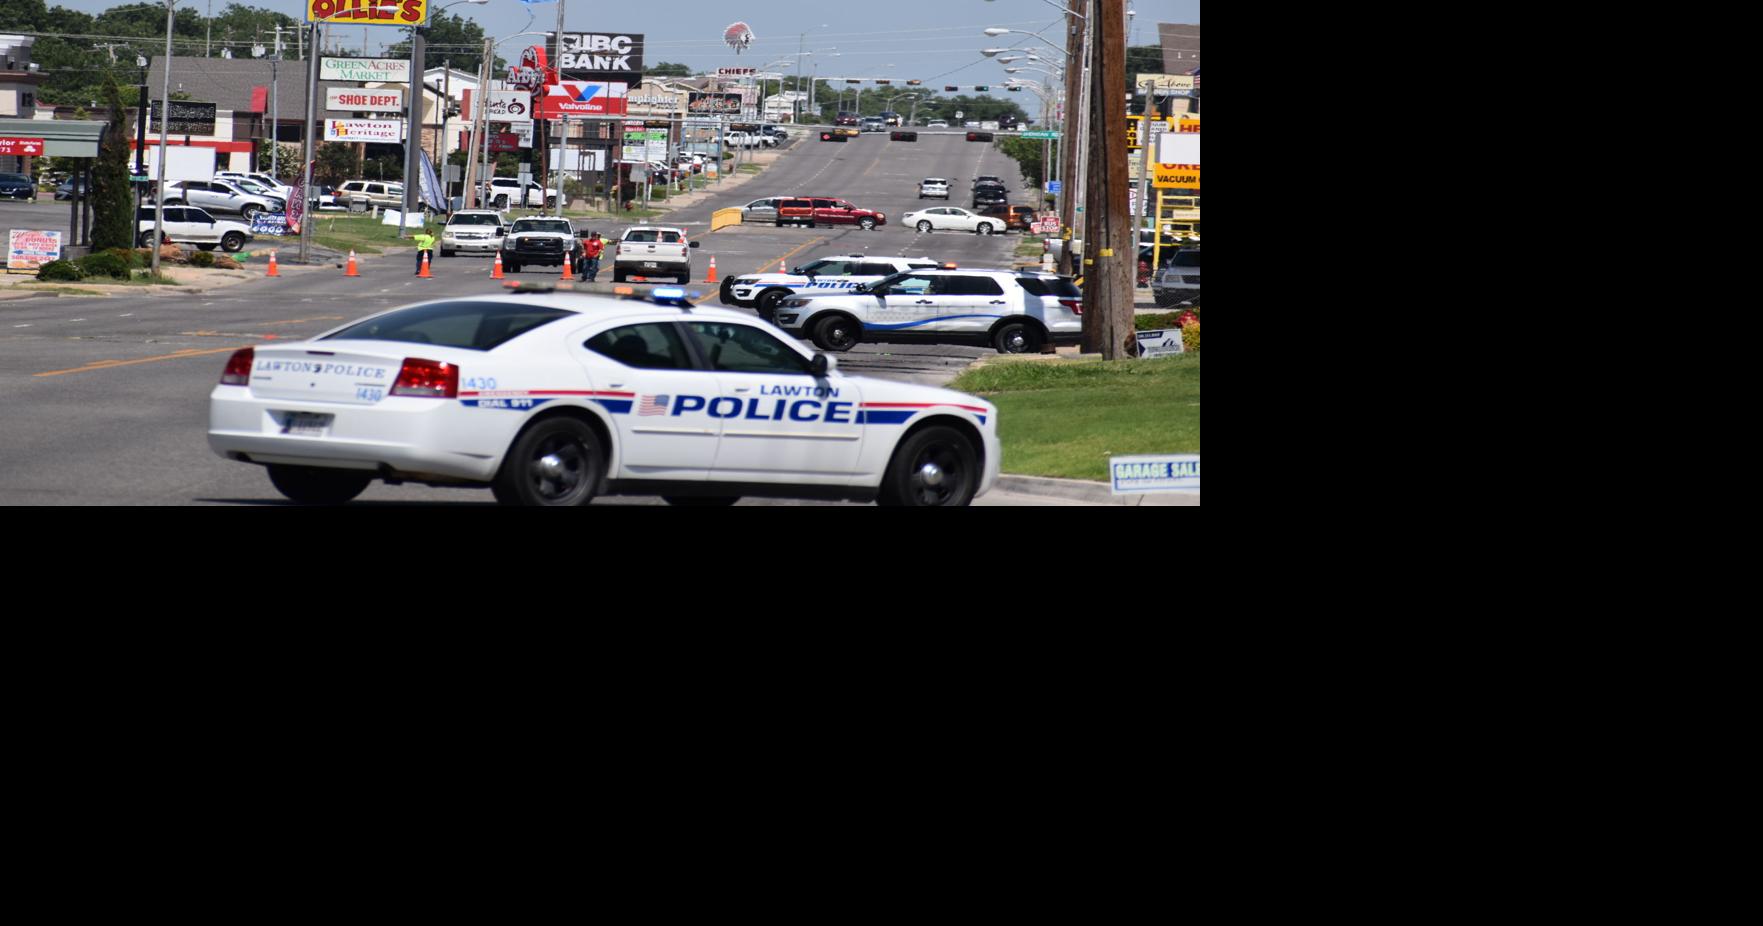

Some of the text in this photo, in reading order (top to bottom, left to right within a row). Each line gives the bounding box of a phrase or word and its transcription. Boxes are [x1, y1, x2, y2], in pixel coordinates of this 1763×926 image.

[561, 53, 631, 70] BANK
[340, 70, 391, 80] MARKET
[338, 94, 400, 107] SHOE DEPT.
[558, 102, 603, 112] Valvoline
[332, 120, 392, 130] Lawton
[336, 128, 396, 138] Heritage
[1156, 175, 1197, 183] VACUUM
[804, 281, 865, 289] POLIC
[256, 360, 386, 379] LAWTON POLICE
[461, 377, 497, 390] 1430
[355, 387, 382, 401] 1430
[759, 384, 839, 398] LAWTON
[478, 398, 534, 408] DIAL 911
[670, 394, 853, 425] POLICE
[1115, 463, 1168, 479] GARAGE
